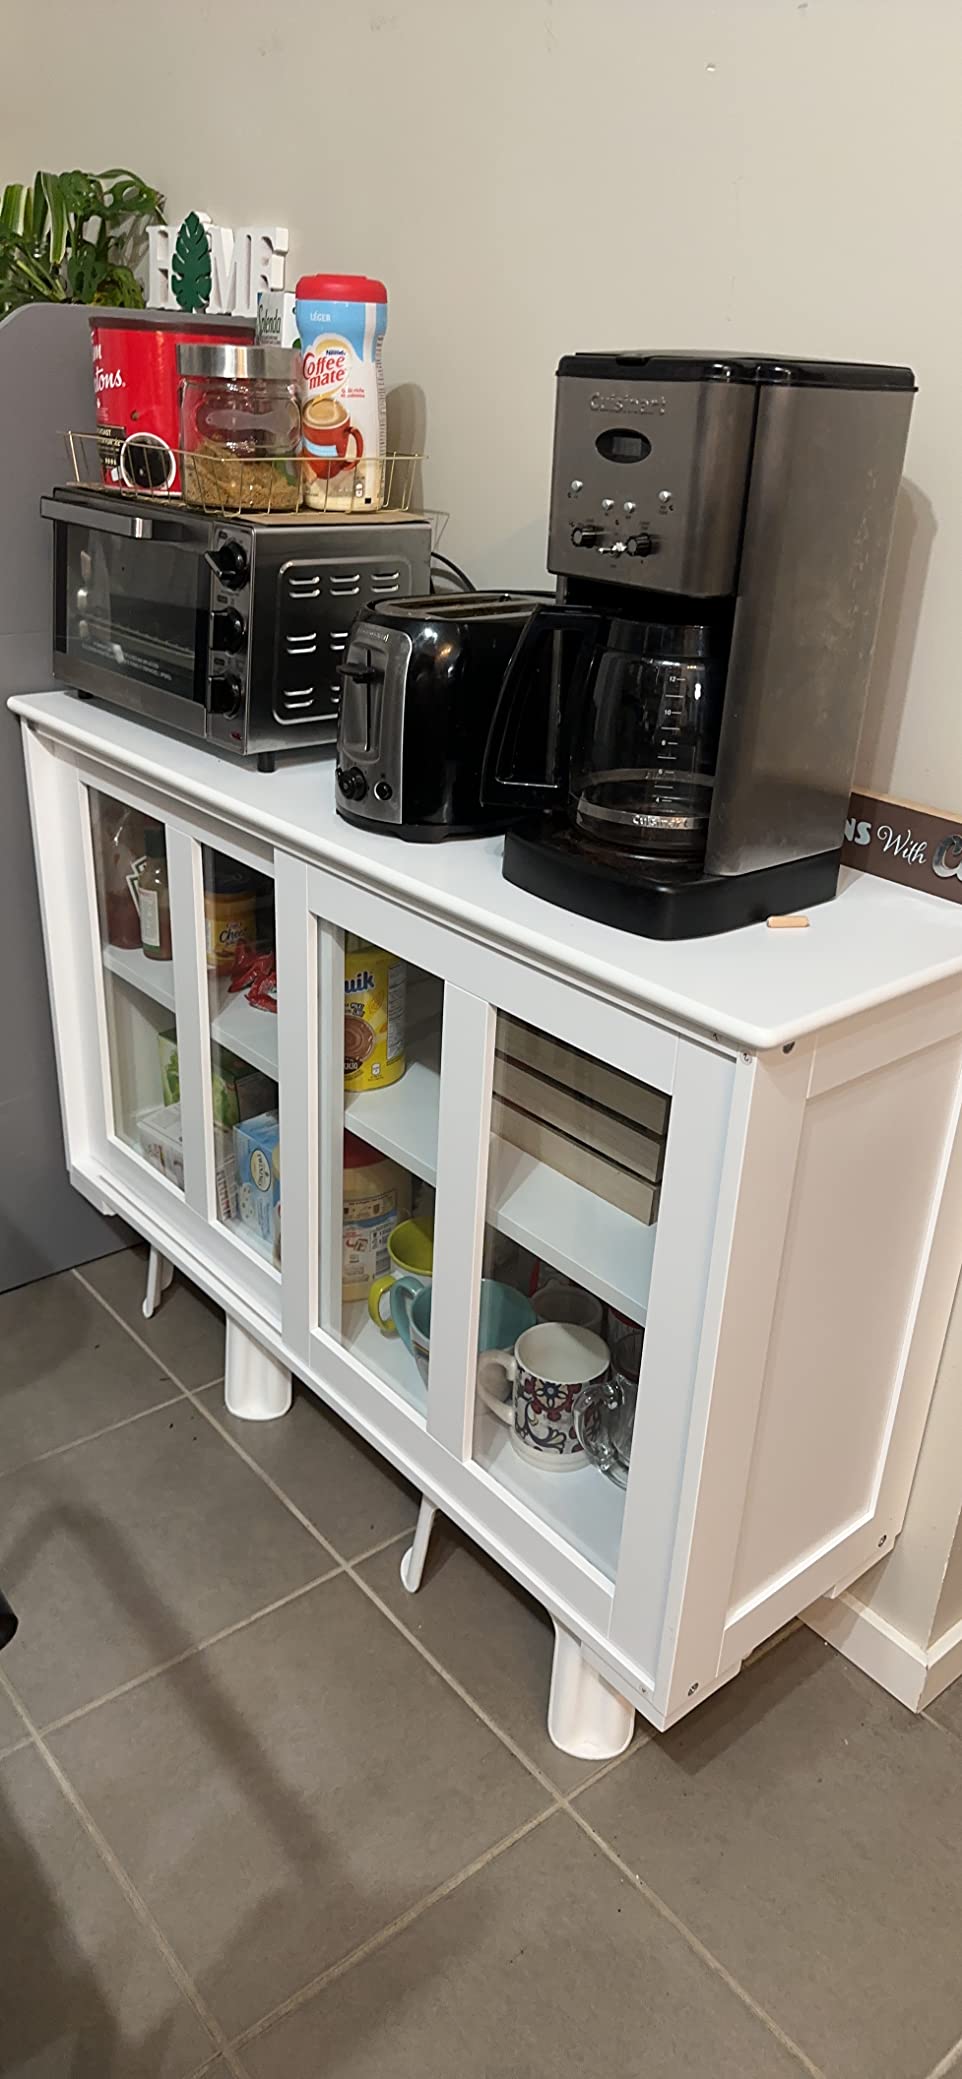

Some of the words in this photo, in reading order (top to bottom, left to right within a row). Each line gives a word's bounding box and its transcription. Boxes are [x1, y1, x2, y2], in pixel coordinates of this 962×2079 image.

[146, 211, 289, 317] HME
[303, 352, 345, 380] Coffee
[309, 369, 345, 394] mate
[590, 391, 667, 416] Cuisinart
[844, 818, 872, 846] NS
[877, 826, 926, 865] With
[345, 971, 375, 993] uik
